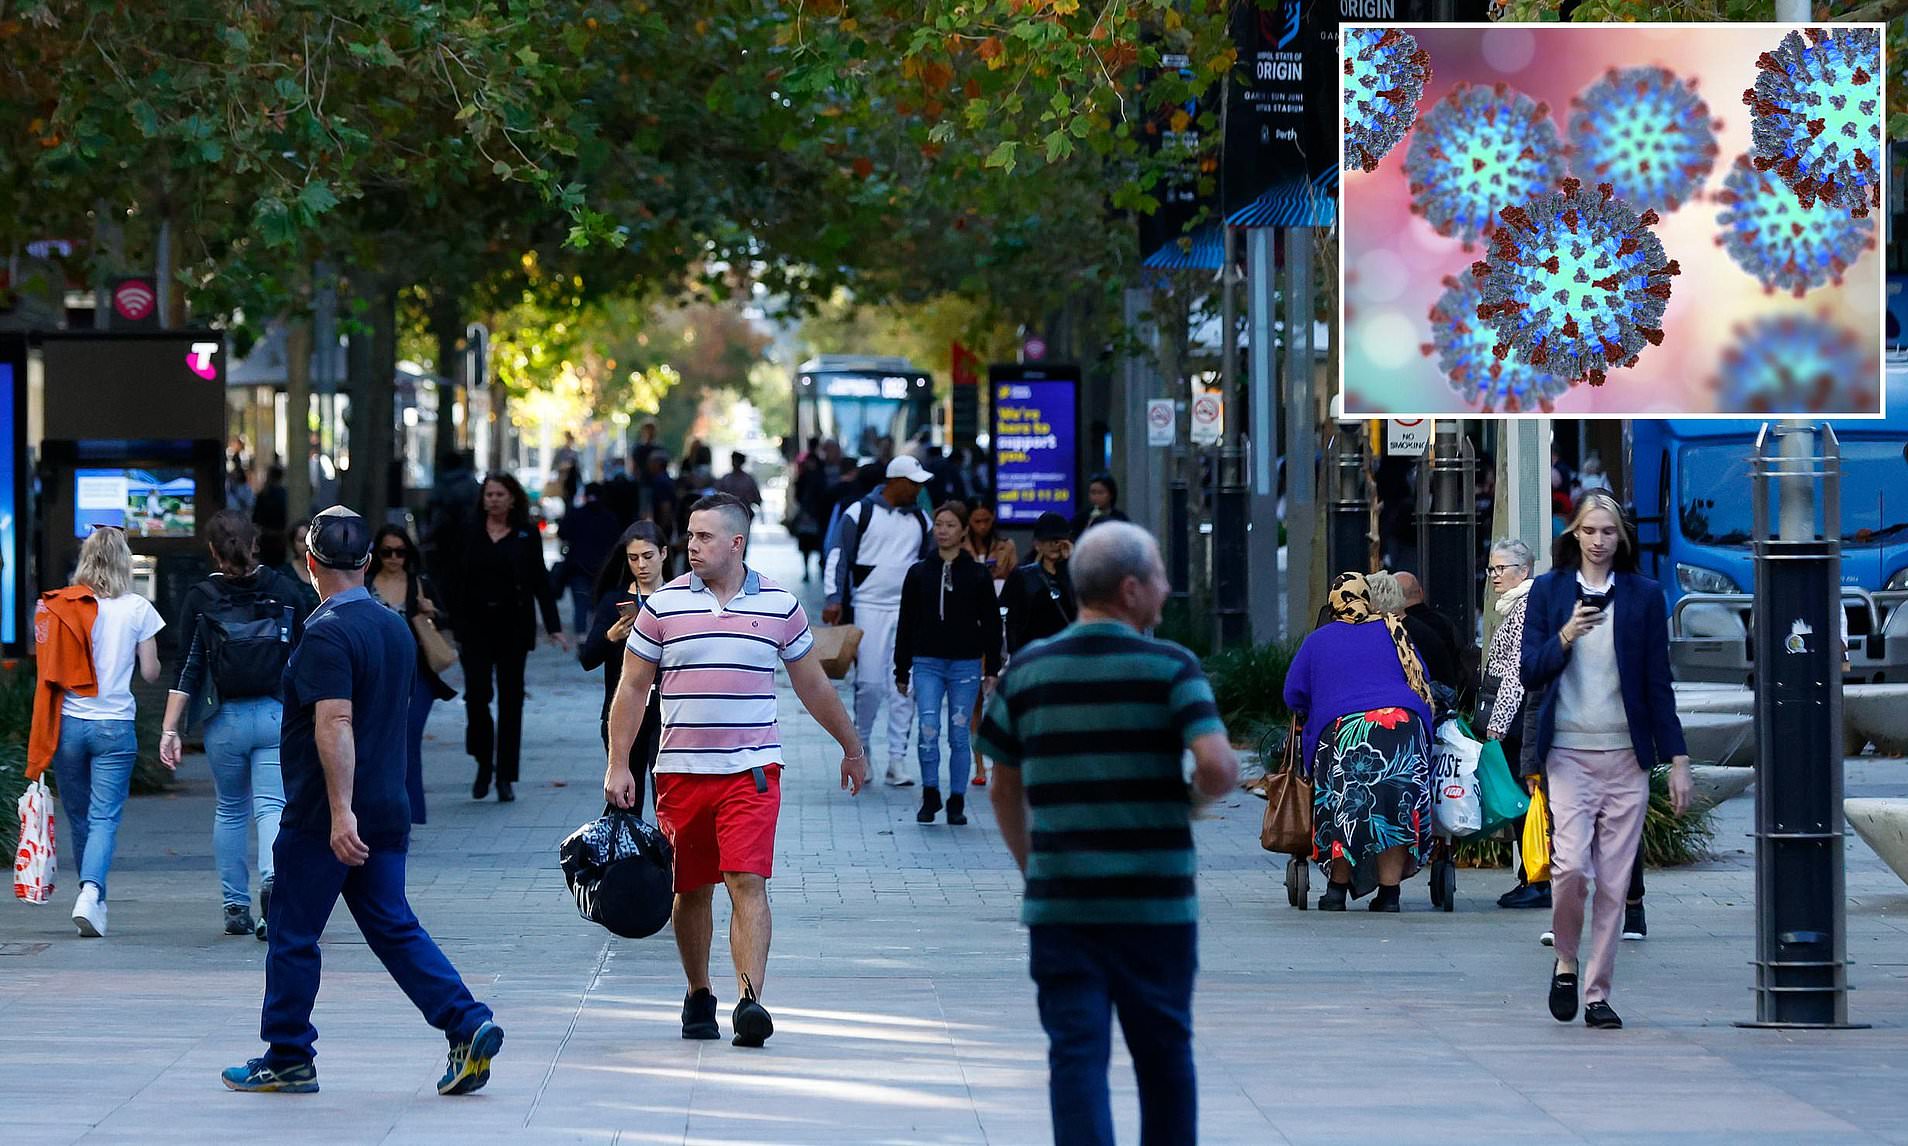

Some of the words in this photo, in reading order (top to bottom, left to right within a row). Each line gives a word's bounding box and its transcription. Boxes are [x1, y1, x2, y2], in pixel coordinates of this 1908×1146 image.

[1340, 0, 1394, 18] ORIGIN
[1275, 52, 1293, 60] STATE
[1294, 52, 1302, 61] OF
[1256, 61, 1303, 80] ORIGIN
[1275, 127, 1298, 141] Perth
[997, 421, 1031, 434] here
[1033, 421, 1050, 434] to
[997, 434, 1057, 452] support
[1402, 432, 1415, 440] NO
